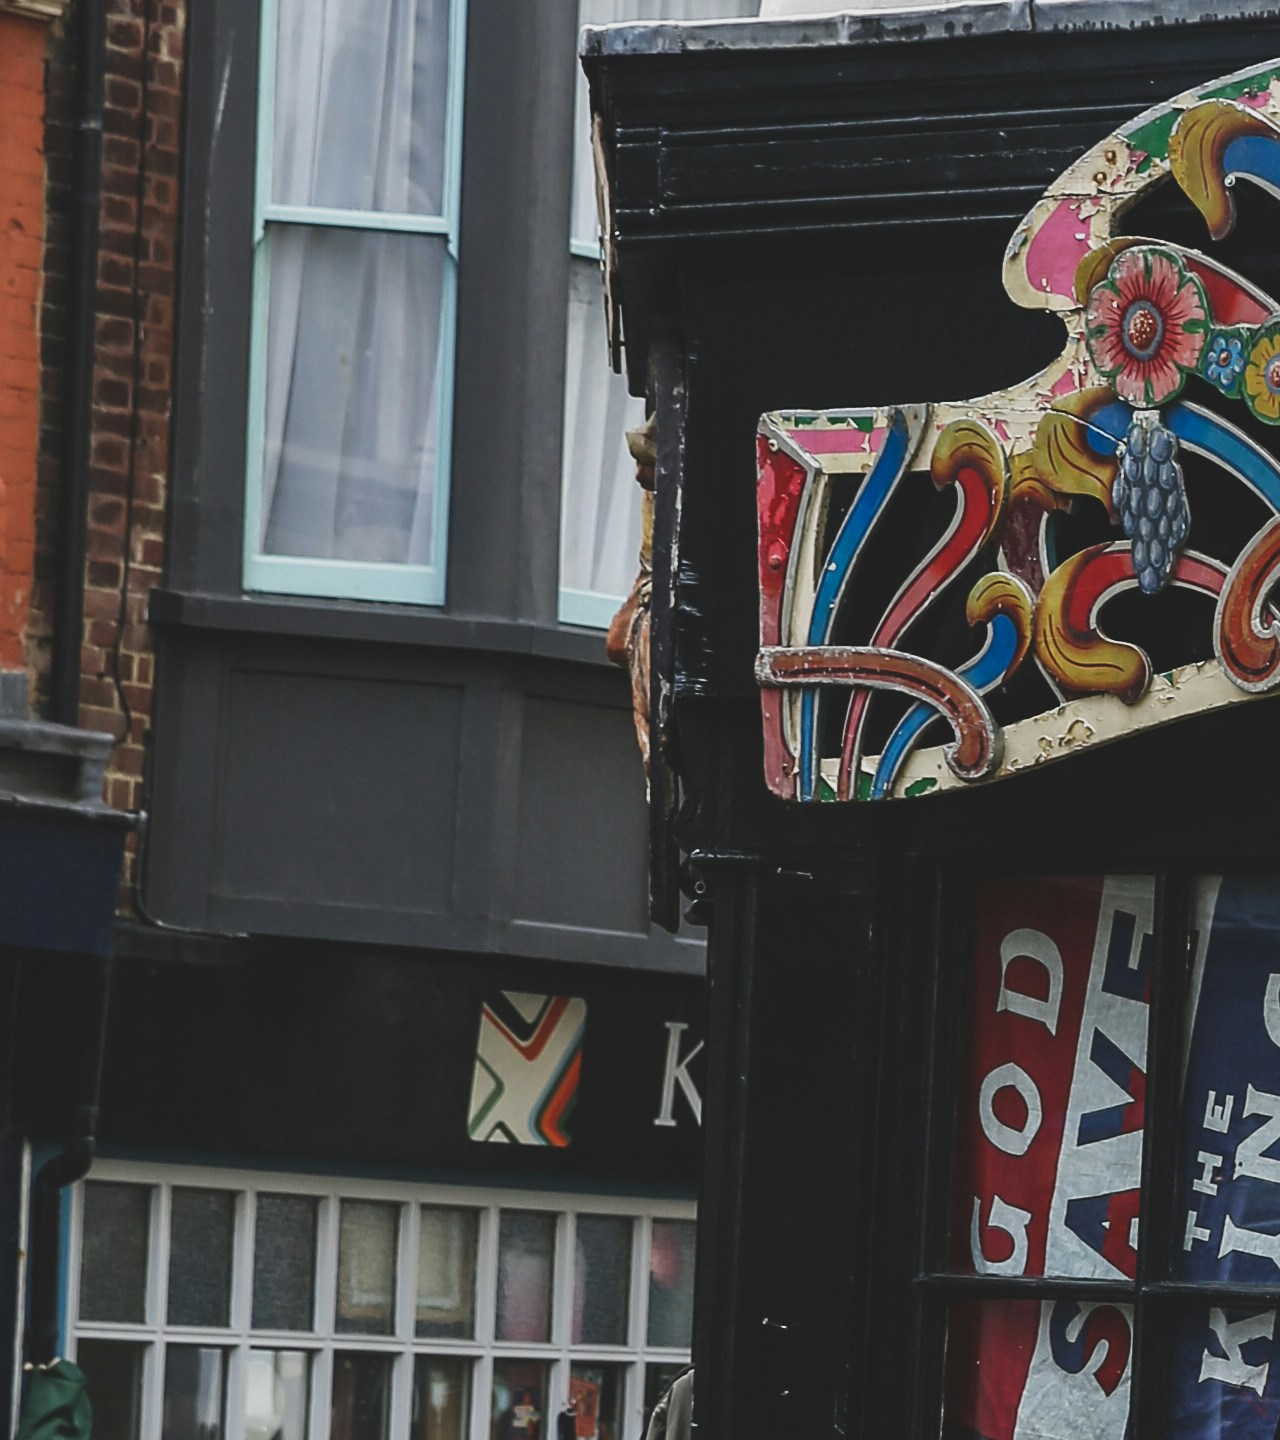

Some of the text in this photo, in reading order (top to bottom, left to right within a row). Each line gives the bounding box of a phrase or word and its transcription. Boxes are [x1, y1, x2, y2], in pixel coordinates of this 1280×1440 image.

[971, 927, 1064, 1277] GOD
[1049, 909, 1155, 1397] SAVE
[1183, 1089, 1236, 1252] THE
